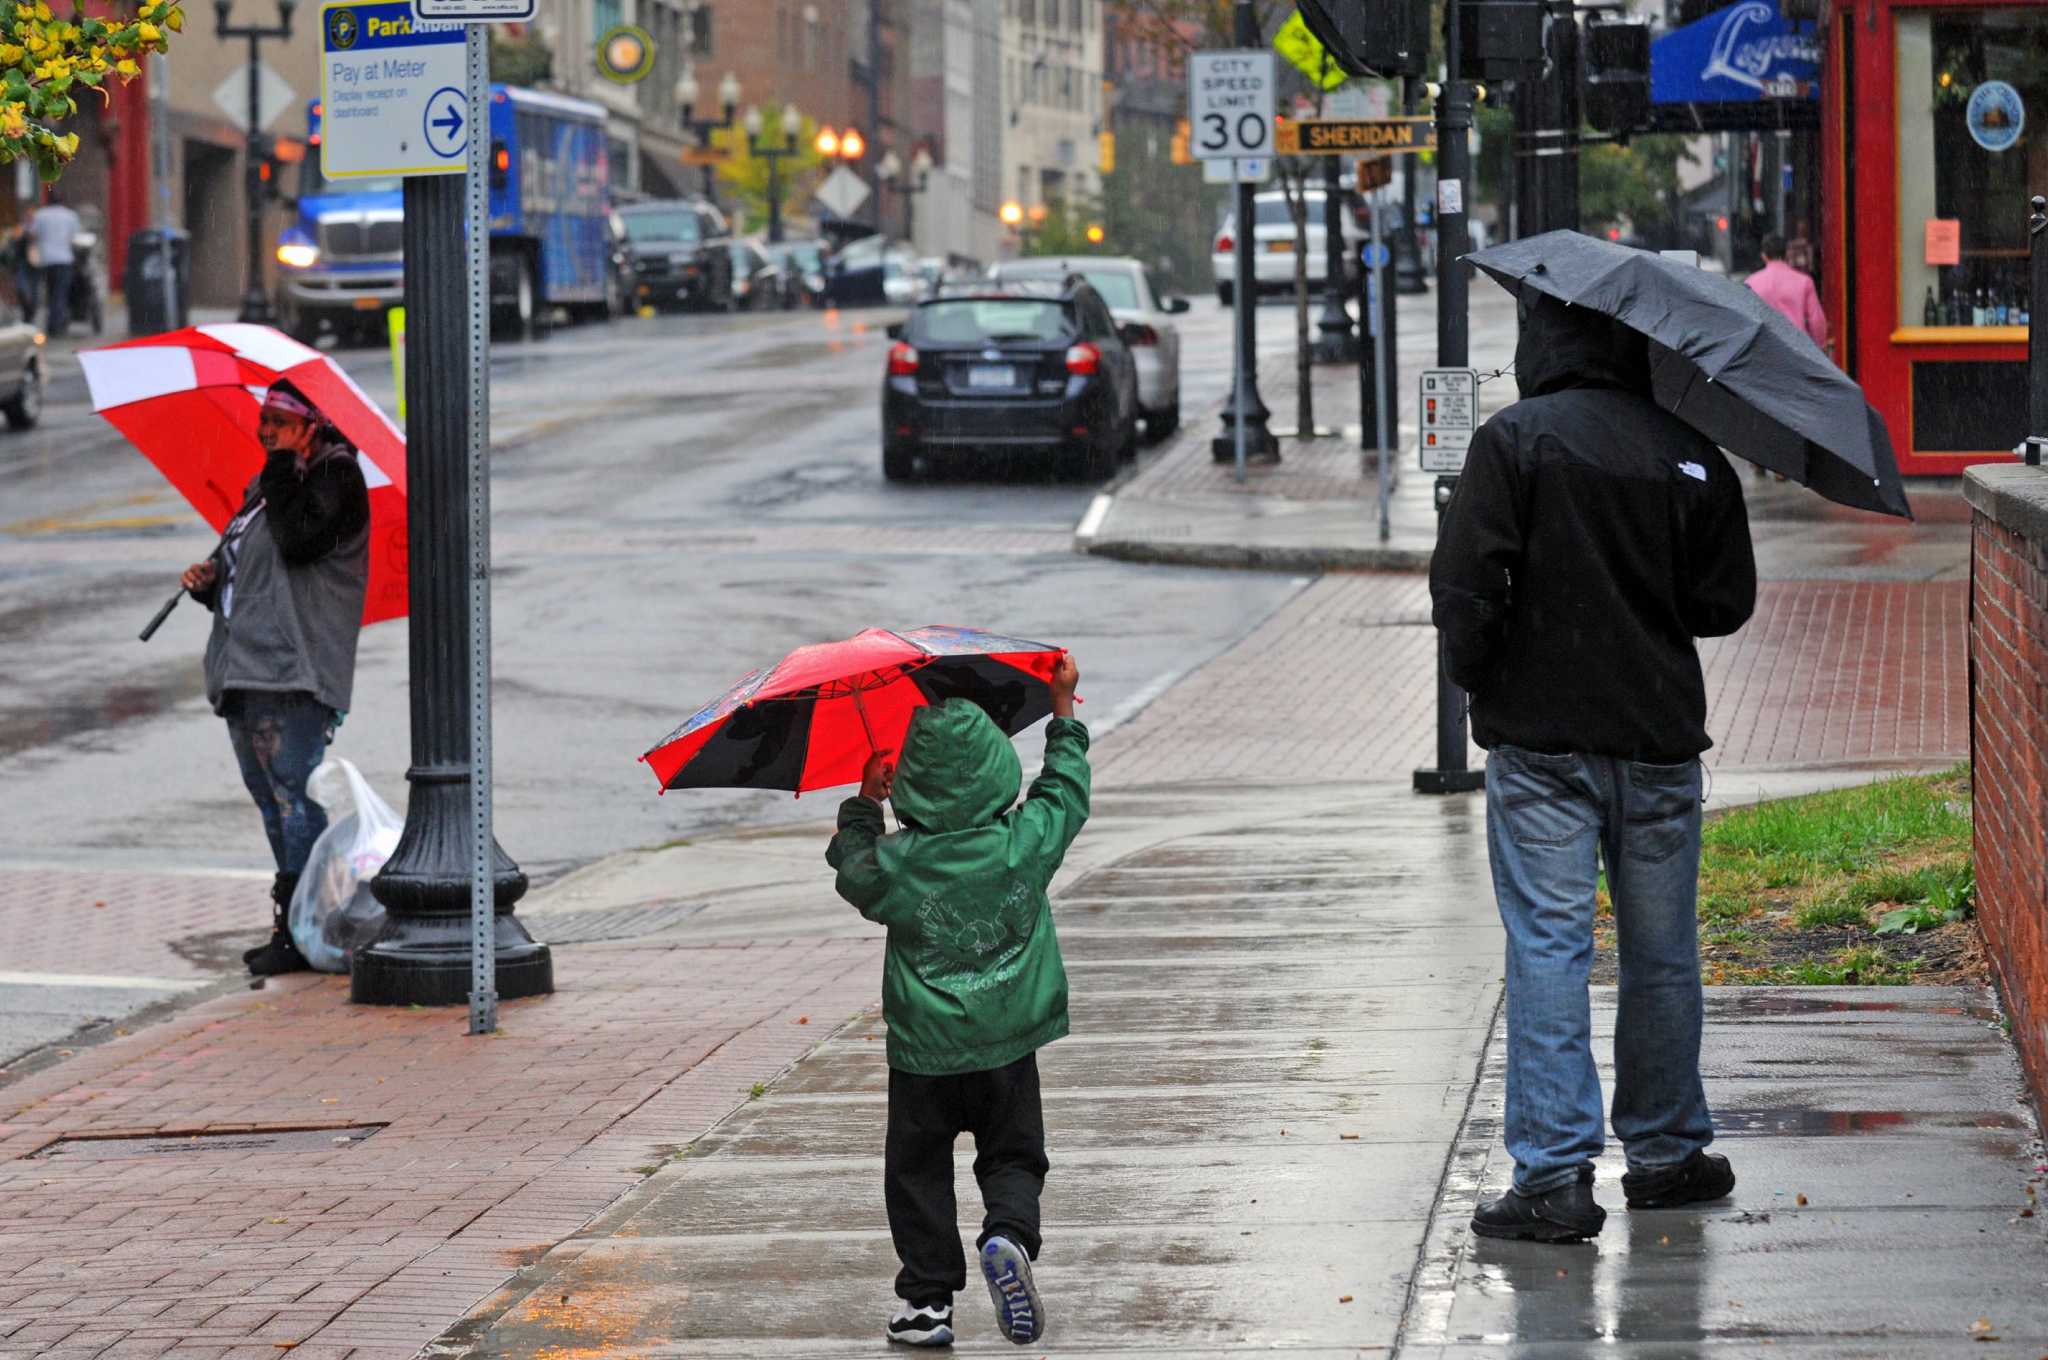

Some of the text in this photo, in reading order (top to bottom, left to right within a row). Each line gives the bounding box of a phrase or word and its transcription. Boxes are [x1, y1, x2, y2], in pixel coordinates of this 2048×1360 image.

[333, 59, 426, 86] Pay at Meter
[1210, 60, 1252, 73] CITY
[1203, 77, 1263, 91] SPEED
[1207, 95, 1256, 109] LIMIT
[1202, 112, 1266, 150] 30
[1310, 126, 1412, 146] SHERIDAN
